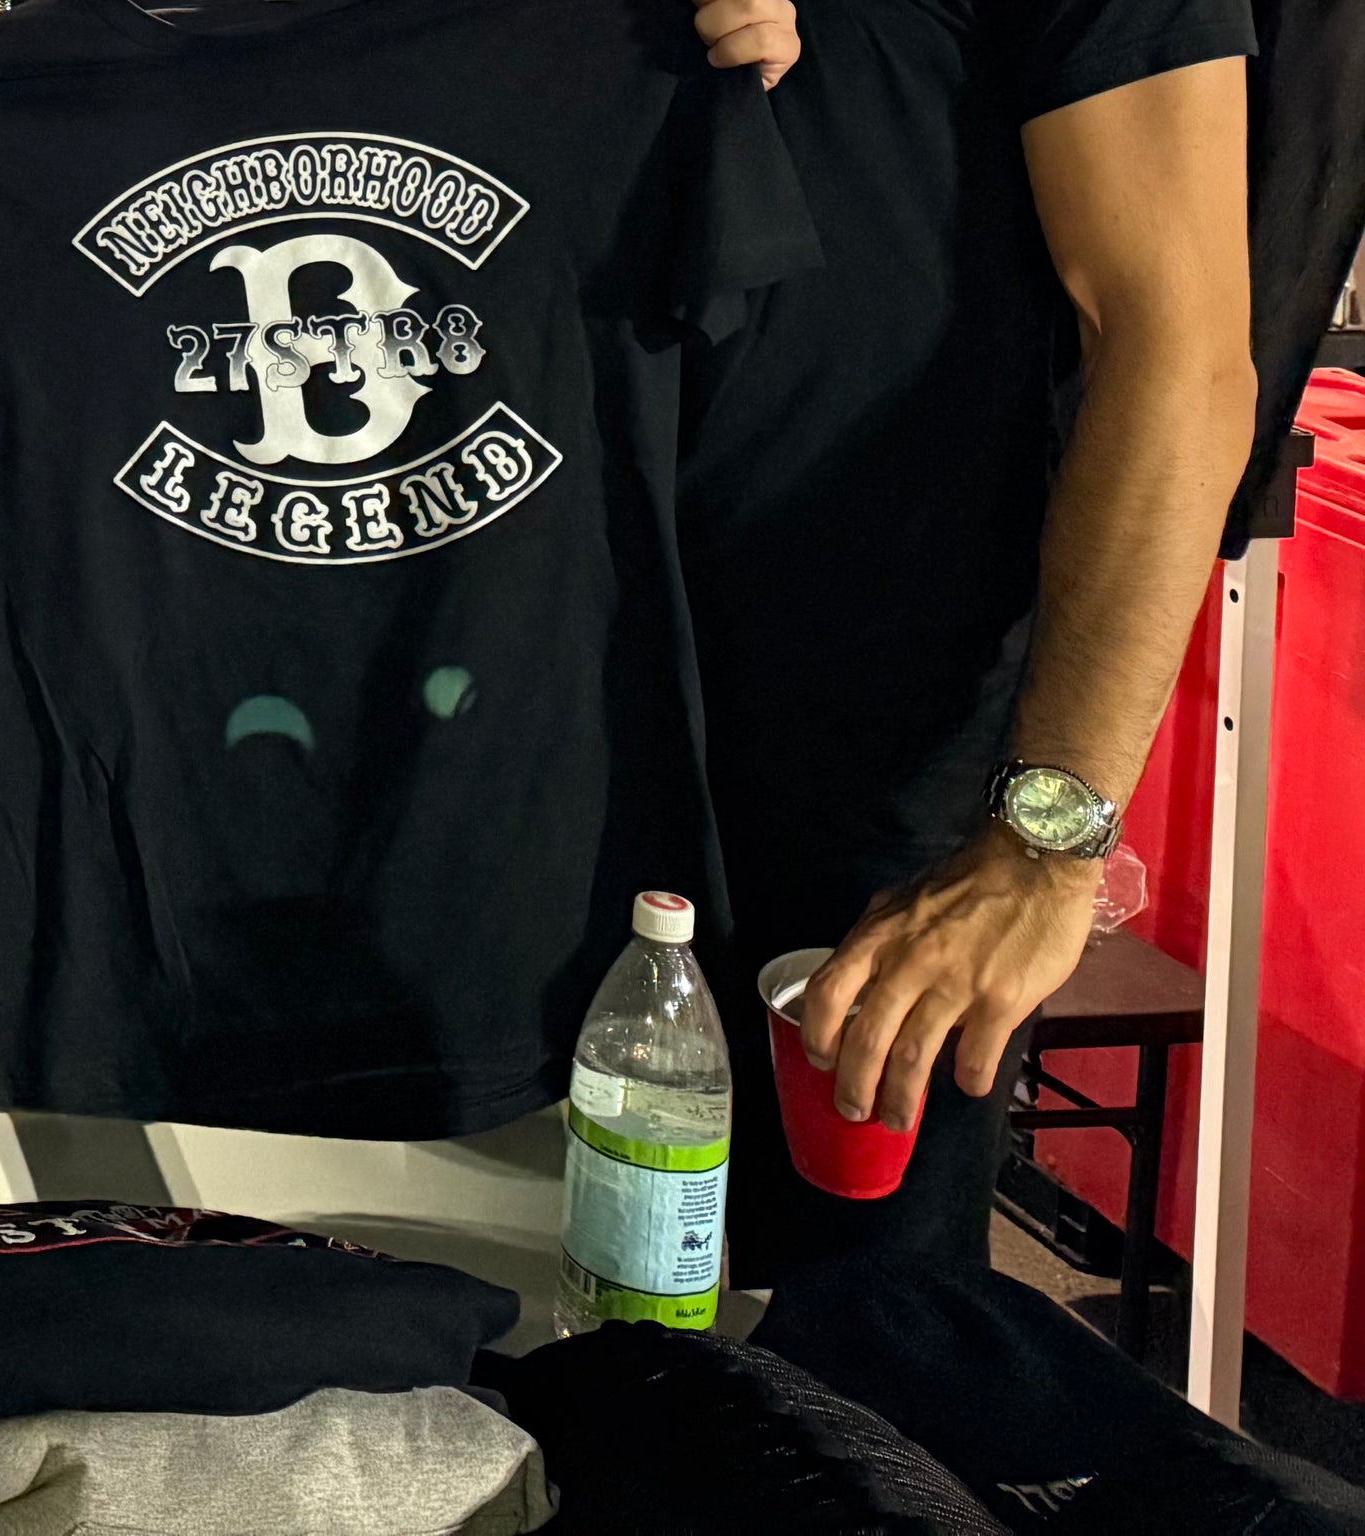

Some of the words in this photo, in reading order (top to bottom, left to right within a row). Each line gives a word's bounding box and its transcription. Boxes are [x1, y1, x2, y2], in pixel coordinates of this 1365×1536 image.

[95, 144, 500, 276] NEIGHBORHOOD
[166, 304, 487, 392] 27STR8
[209, 234, 434, 464] B
[140, 431, 533, 555] LEGEND
